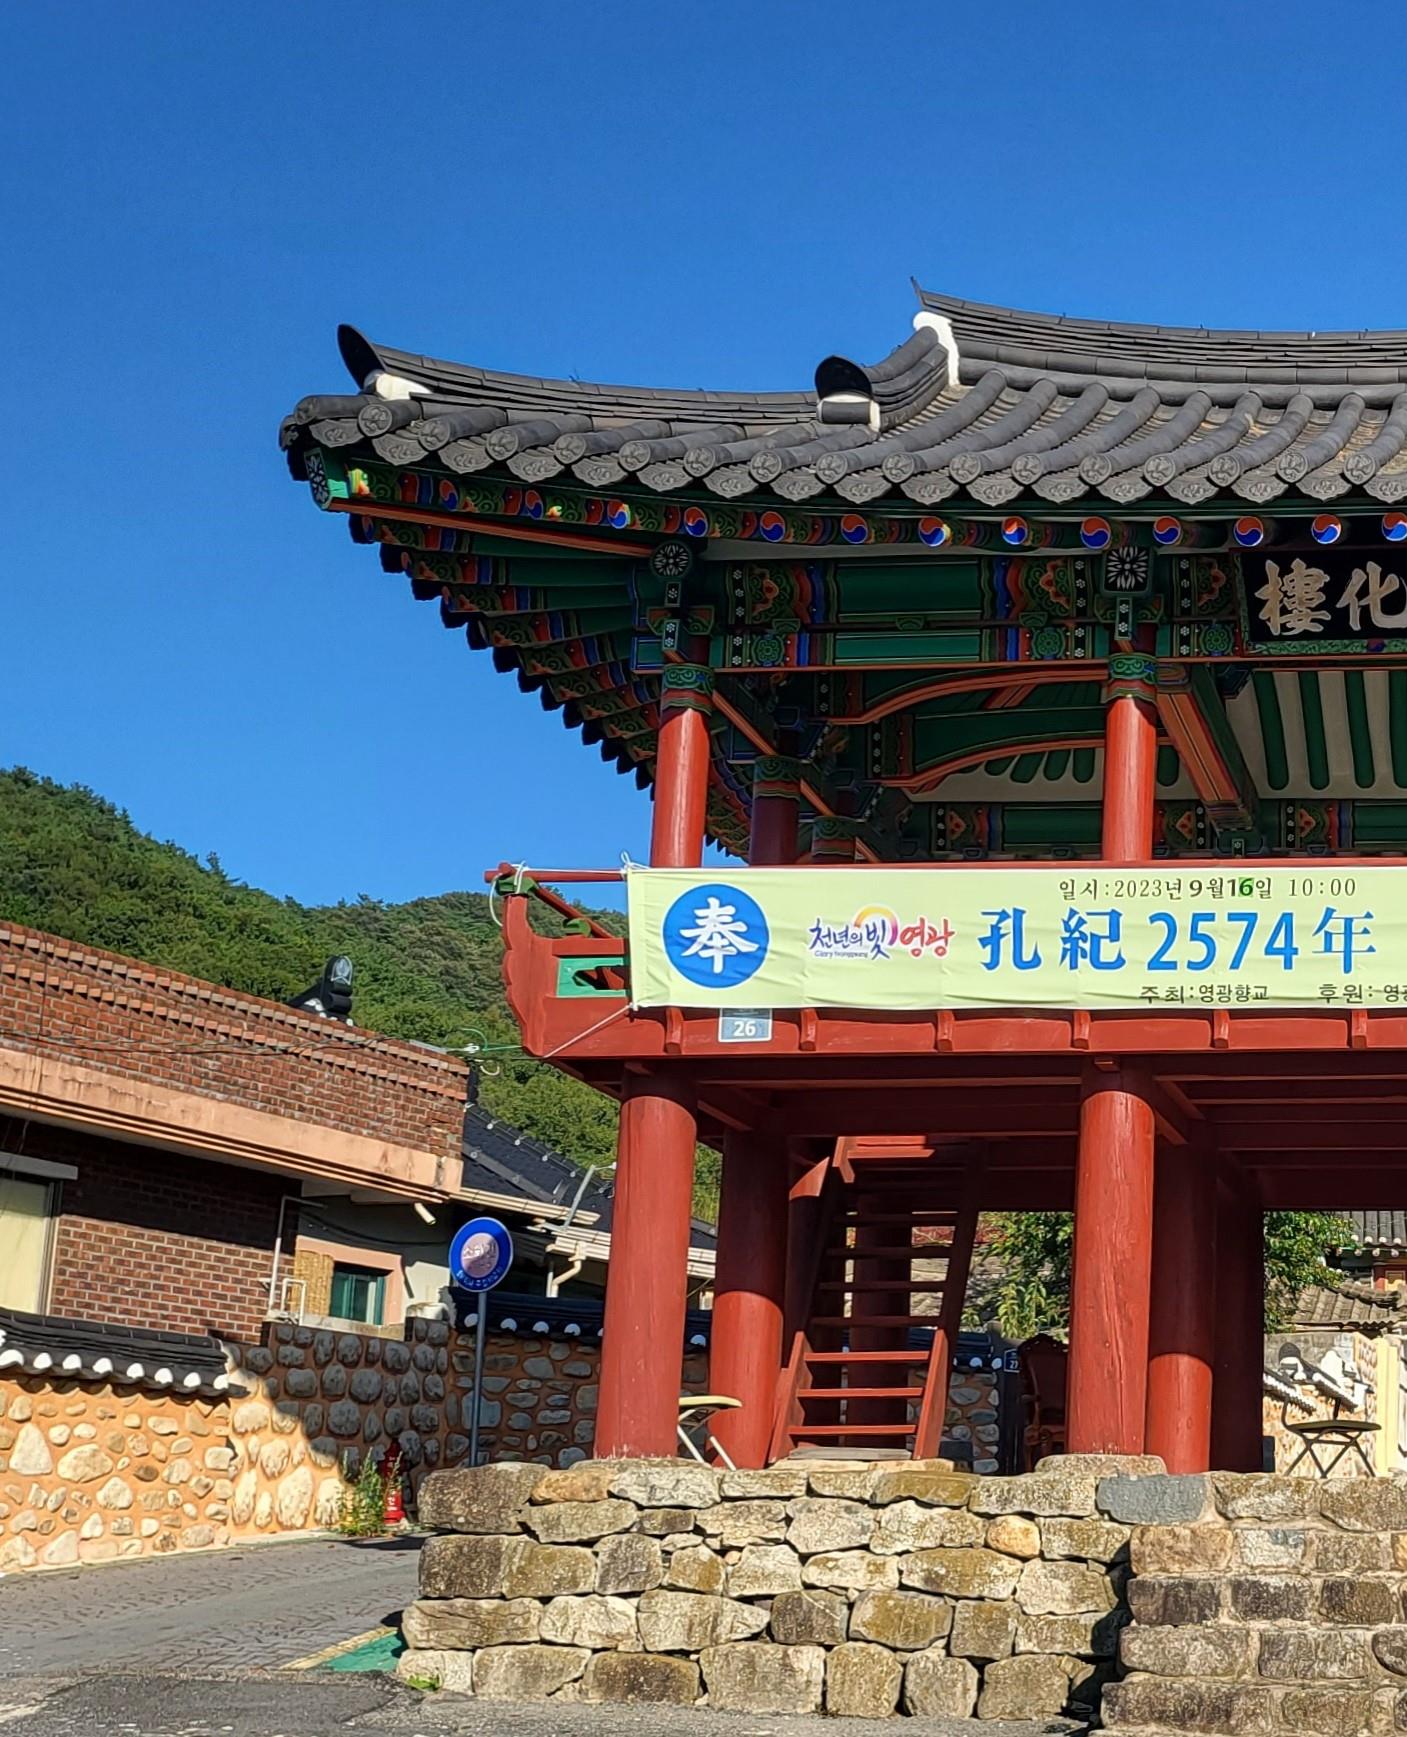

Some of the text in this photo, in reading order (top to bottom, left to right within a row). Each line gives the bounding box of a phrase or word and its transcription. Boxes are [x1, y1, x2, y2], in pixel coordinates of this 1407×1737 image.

[1288, 877, 1356, 897] 10:00
[679, 896, 760, 975] 奉
[733, 1020, 757, 1037] 26
